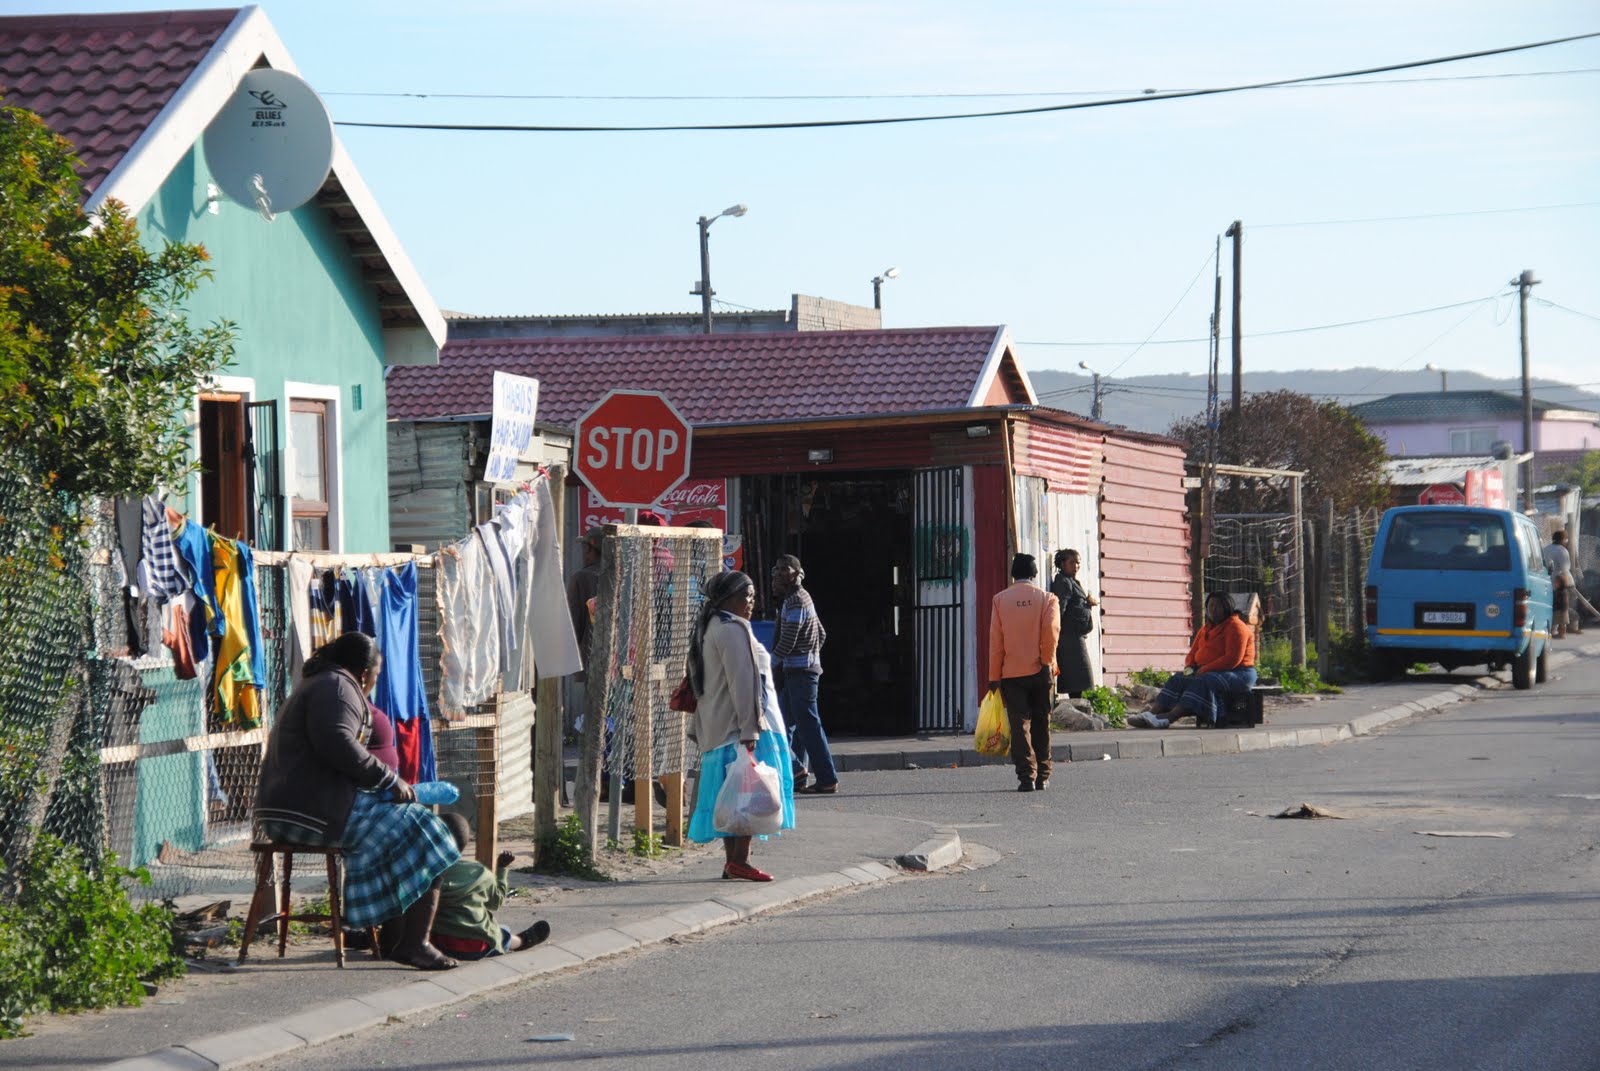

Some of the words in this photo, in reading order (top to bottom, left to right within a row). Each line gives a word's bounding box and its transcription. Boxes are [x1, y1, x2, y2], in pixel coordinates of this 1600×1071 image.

[256, 111, 282, 120] ELLIES
[587, 426, 679, 471] STOP
[662, 484, 721, 505] oca-Cola
[1428, 613, 1437, 621] CA
